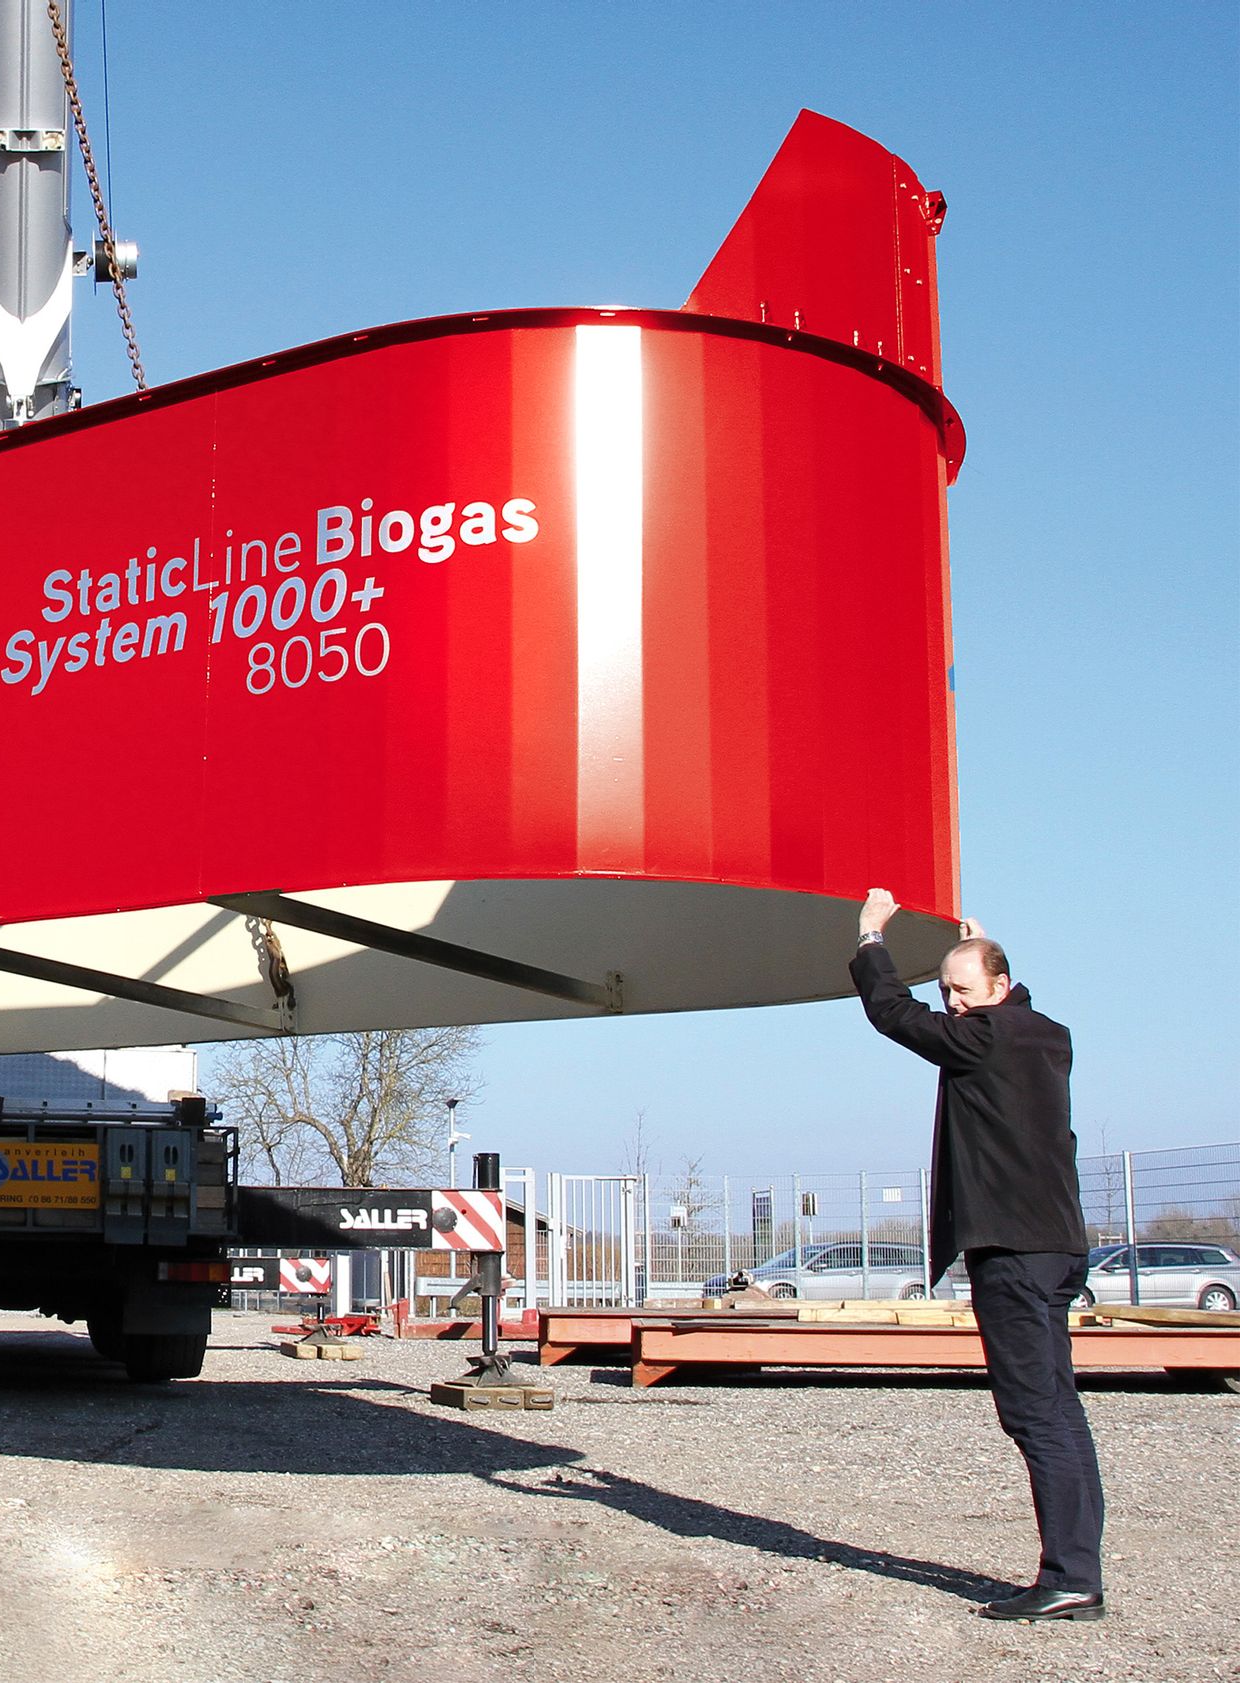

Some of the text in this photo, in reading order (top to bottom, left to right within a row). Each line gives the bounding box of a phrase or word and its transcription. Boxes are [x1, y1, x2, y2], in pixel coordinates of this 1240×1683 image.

[316, 497, 540, 565] Biogas
[0, 567, 385, 696] System 1000+
[245, 622, 391, 696] 8050
[339, 1208, 428, 1230] SALLER
[230, 1266, 265, 1282] LER
